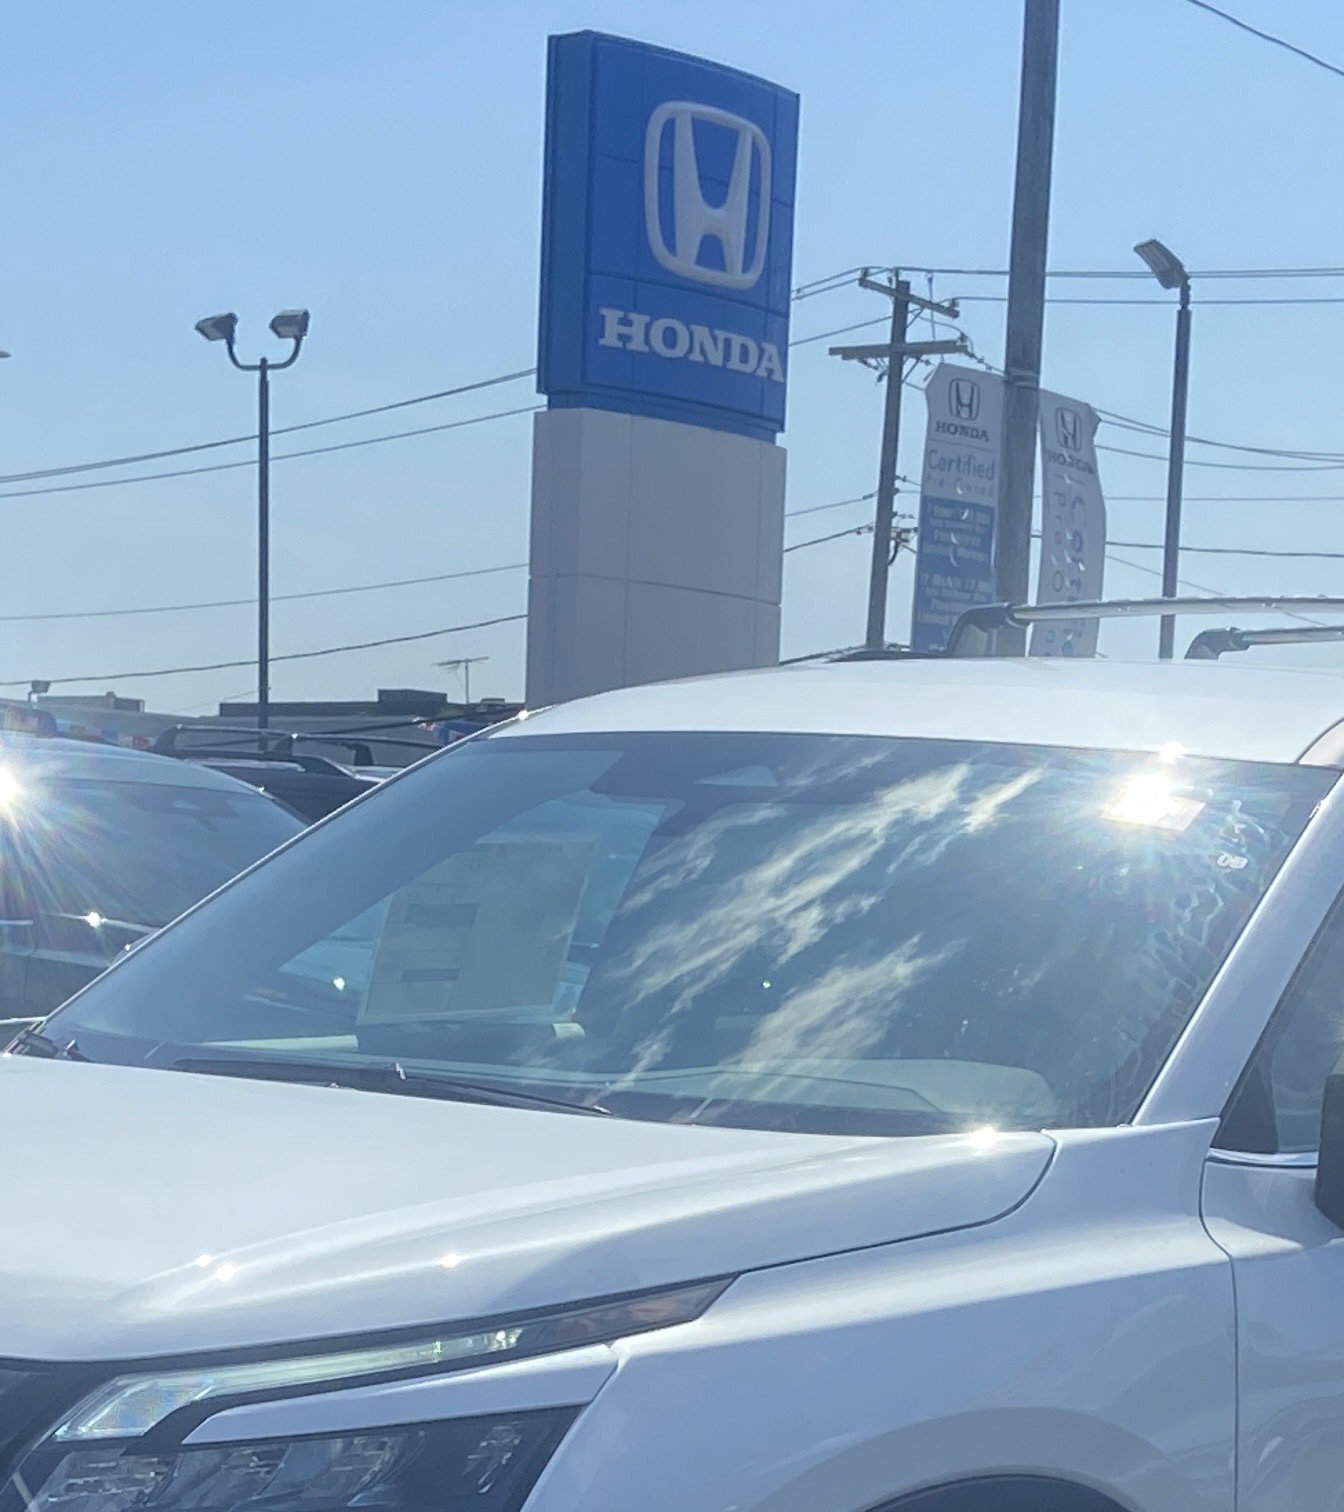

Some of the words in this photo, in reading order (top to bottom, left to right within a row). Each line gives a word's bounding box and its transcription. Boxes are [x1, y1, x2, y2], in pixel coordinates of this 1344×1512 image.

[598, 308, 784, 383] HONDA
[935, 420, 989, 442] HONDA
[928, 449, 995, 481] Certified
